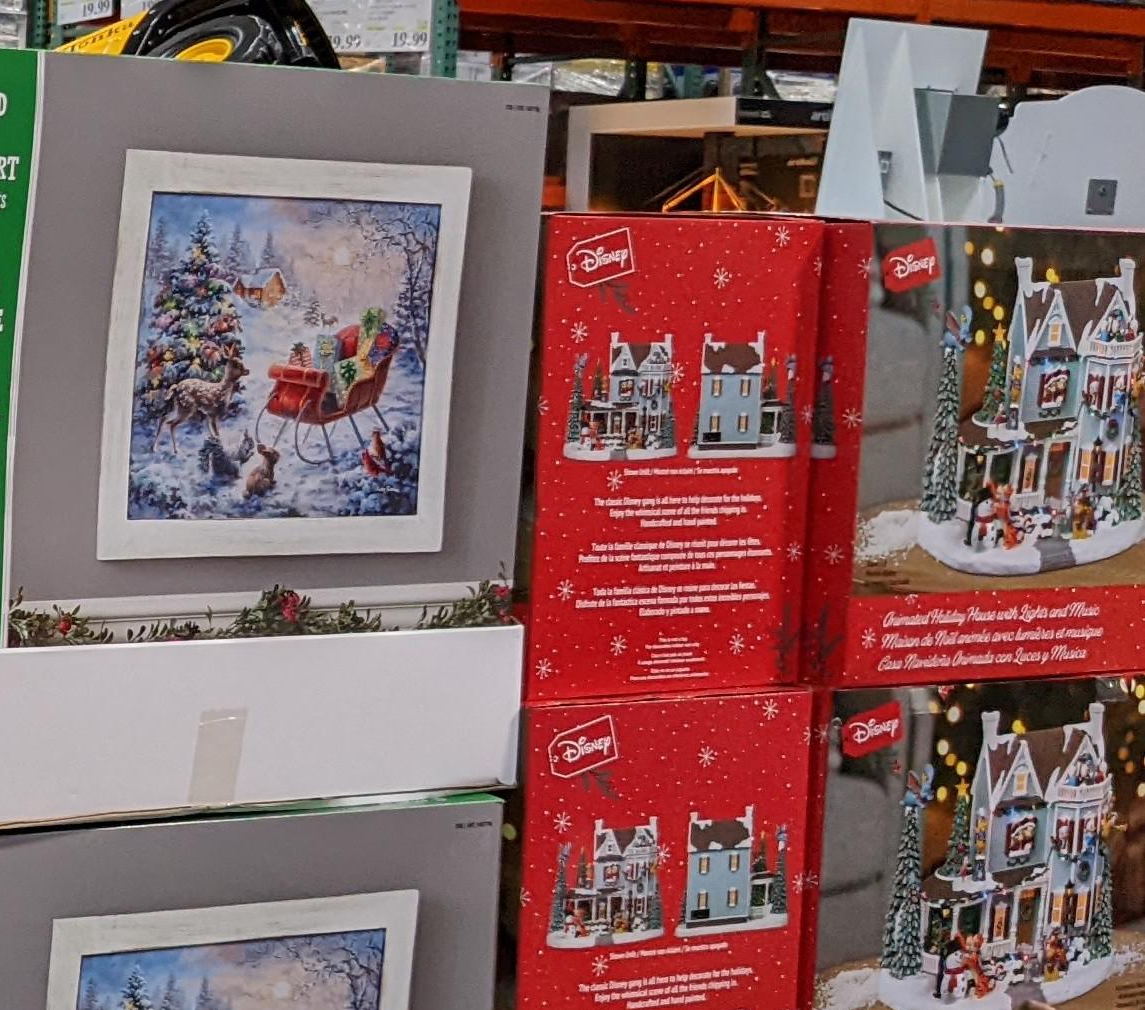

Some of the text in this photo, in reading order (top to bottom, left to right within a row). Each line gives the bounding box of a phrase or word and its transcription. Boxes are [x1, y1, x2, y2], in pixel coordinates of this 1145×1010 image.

[82, 0, 110, 17] 19.99
[392, 32, 428, 48] 19.99
[576, 246, 628, 272] Disney
[889, 254, 936, 279] Disney
[883, 602, 1099, 627] Animated Holiday House with Lights and Music
[881, 633, 920, 649] Maison
[921, 634, 933, 647] de
[991, 631, 1015, 642] avec
[1055, 627, 1066, 638] et
[1066, 625, 1104, 640] musique
[878, 655, 903, 672] Casa
[952, 650, 995, 666] Animada
[995, 652, 1013, 664] con
[1013, 647, 1040, 665] Luces
[1040, 651, 1049, 664] y
[849, 718, 899, 744] Disney
[557, 735, 612, 763] Disney
